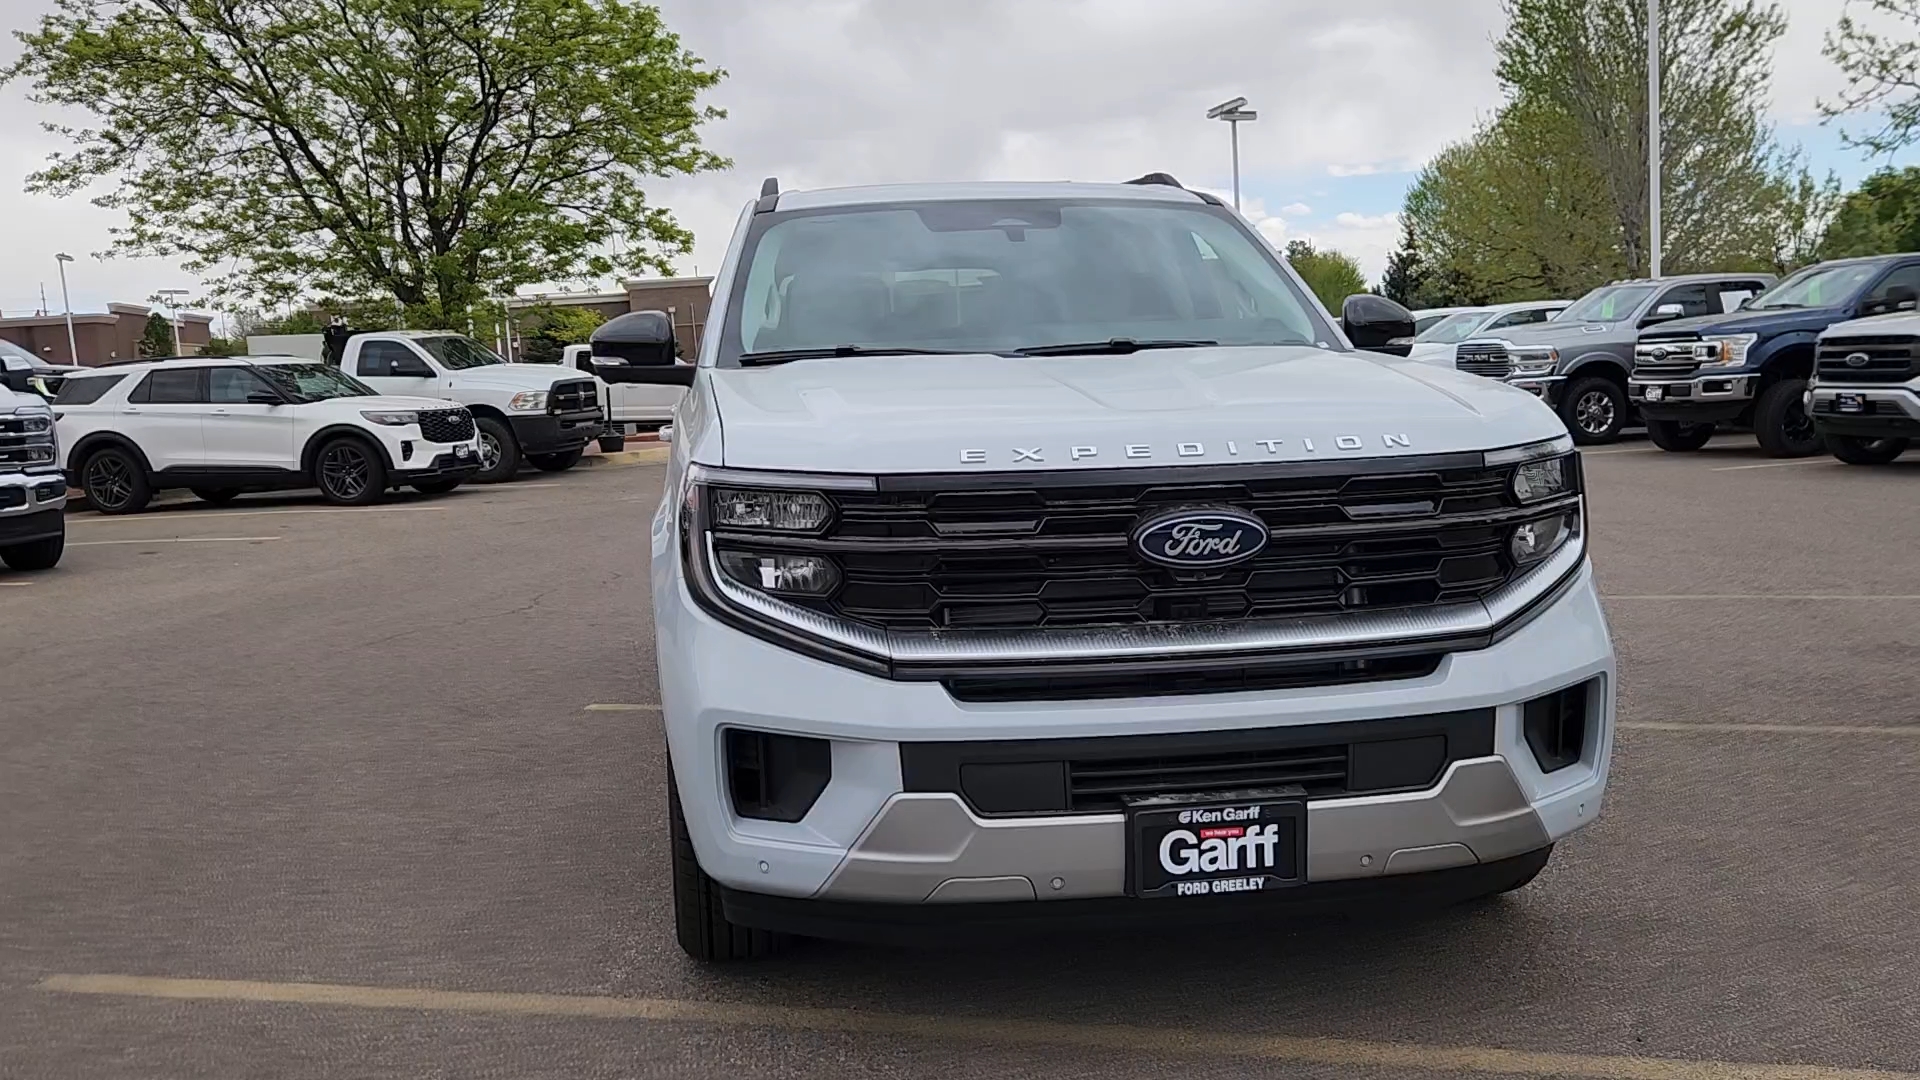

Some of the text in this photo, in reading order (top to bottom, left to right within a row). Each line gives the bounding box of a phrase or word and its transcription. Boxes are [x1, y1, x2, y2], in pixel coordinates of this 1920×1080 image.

[960, 433, 1411, 463] EXPEDITION
[1164, 523, 1242, 556] Ford
[1192, 806, 1260, 823] Ken Garff
[1159, 824, 1279, 874] Garff
[1177, 877, 1265, 895] FORD GREELEY
